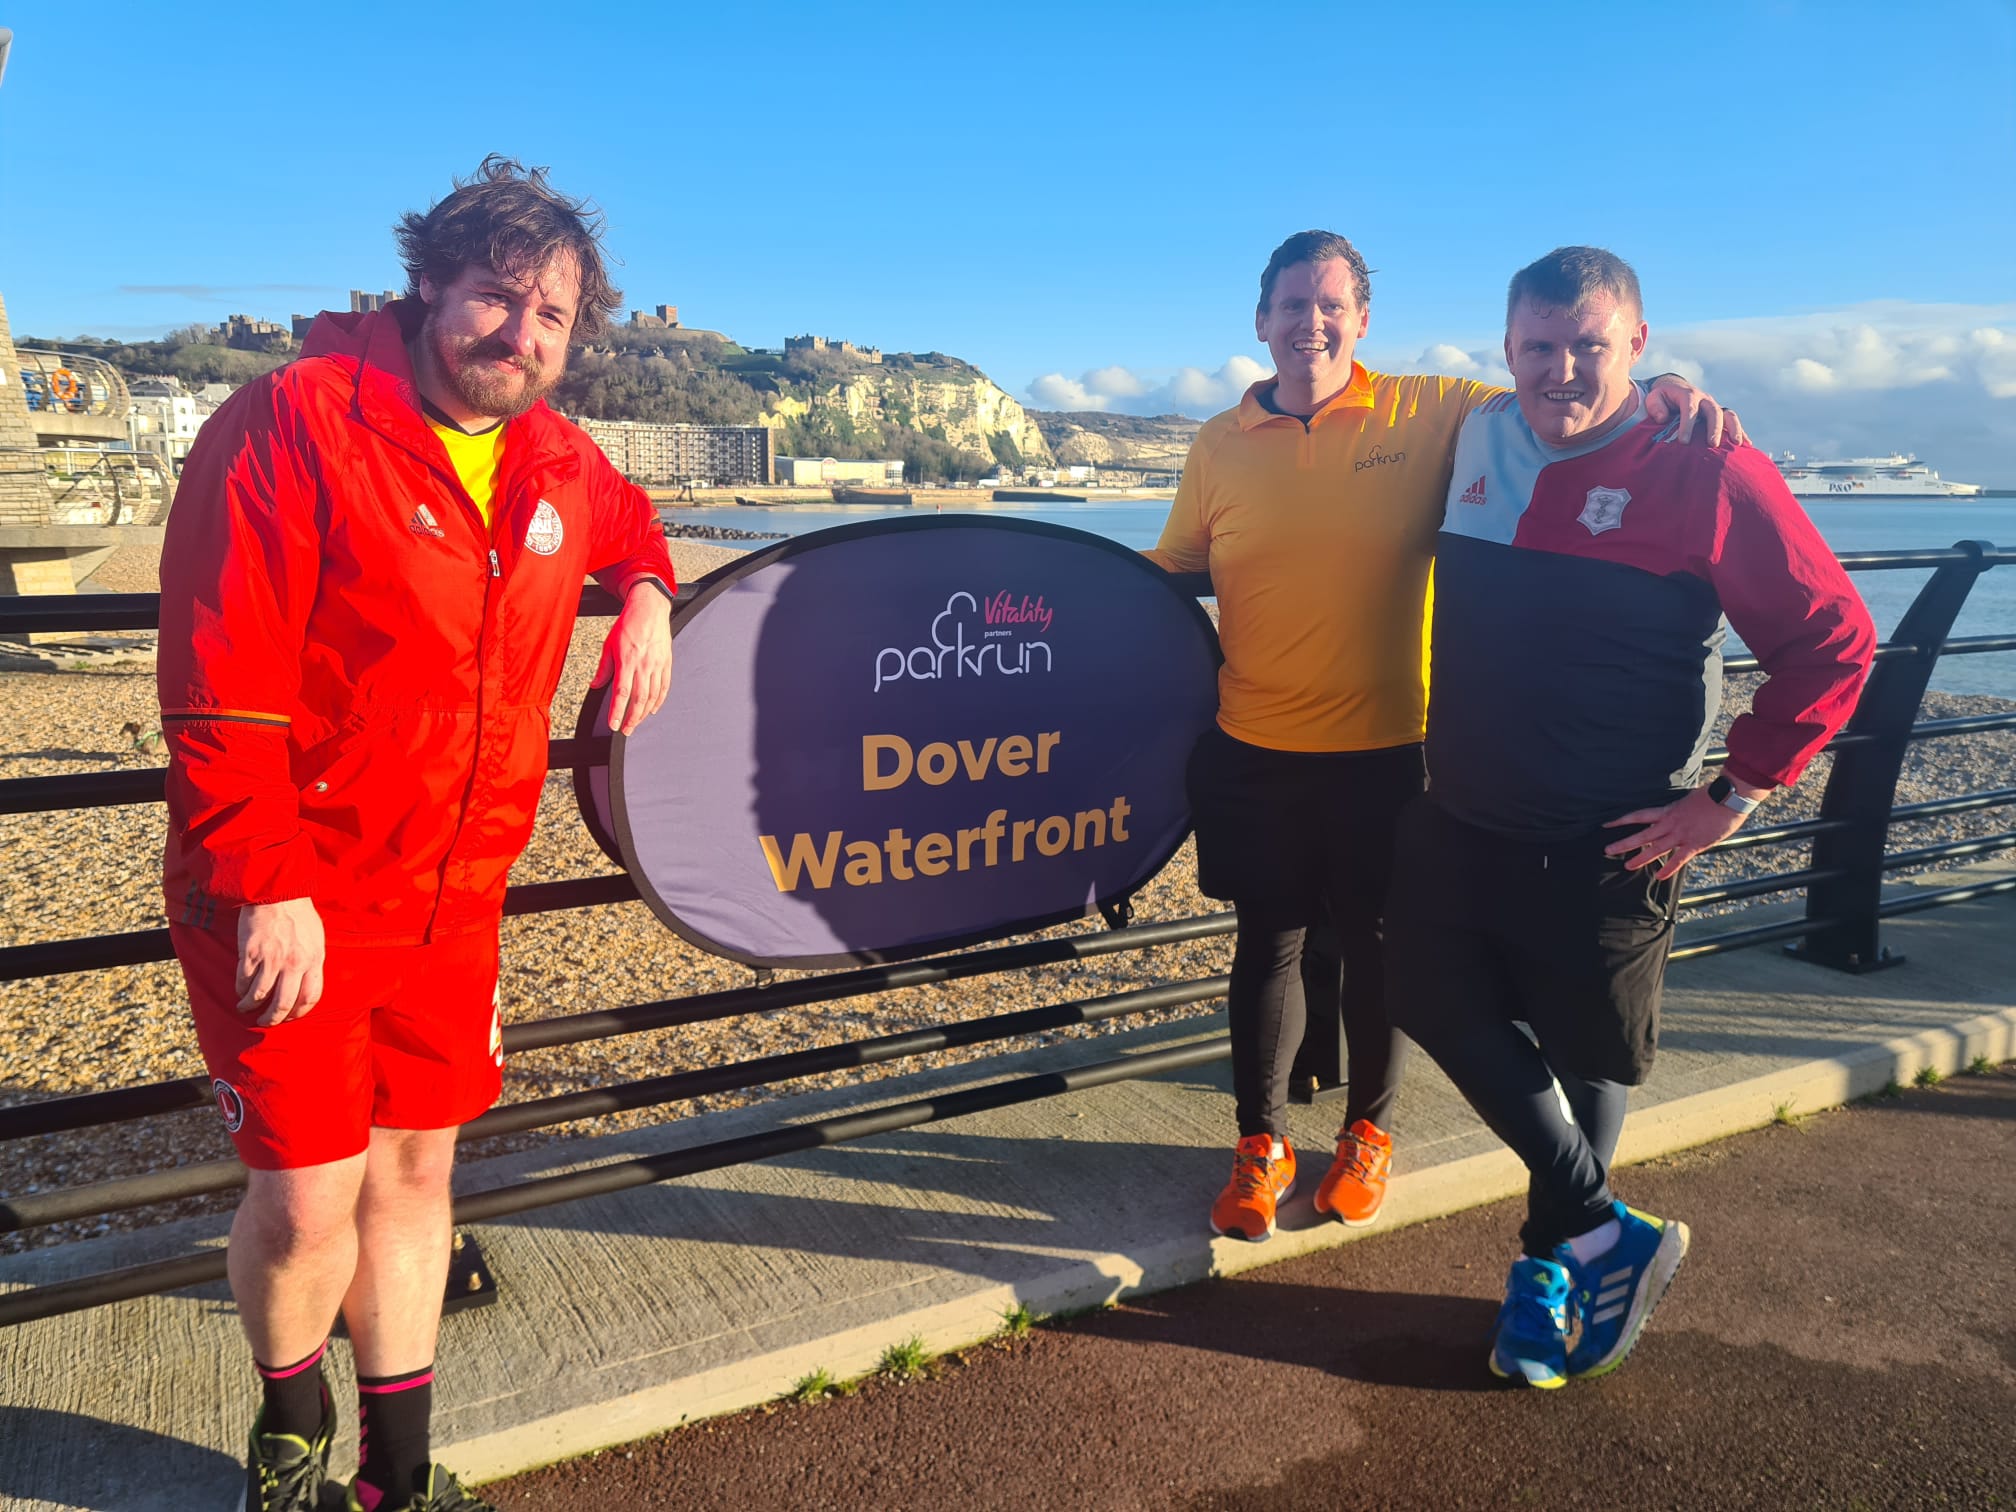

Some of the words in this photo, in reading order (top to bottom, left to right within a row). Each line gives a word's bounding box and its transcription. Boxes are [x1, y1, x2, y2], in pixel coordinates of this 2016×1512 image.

[1354, 444, 1406, 472] parkrun
[1828, 482, 1852, 493] P&O
[984, 589, 1053, 633] Vitality
[873, 591, 1052, 693] parkrun
[984, 630, 1013, 639] partners
[862, 730, 1061, 792] Dover
[758, 796, 1132, 892] Waterfront
